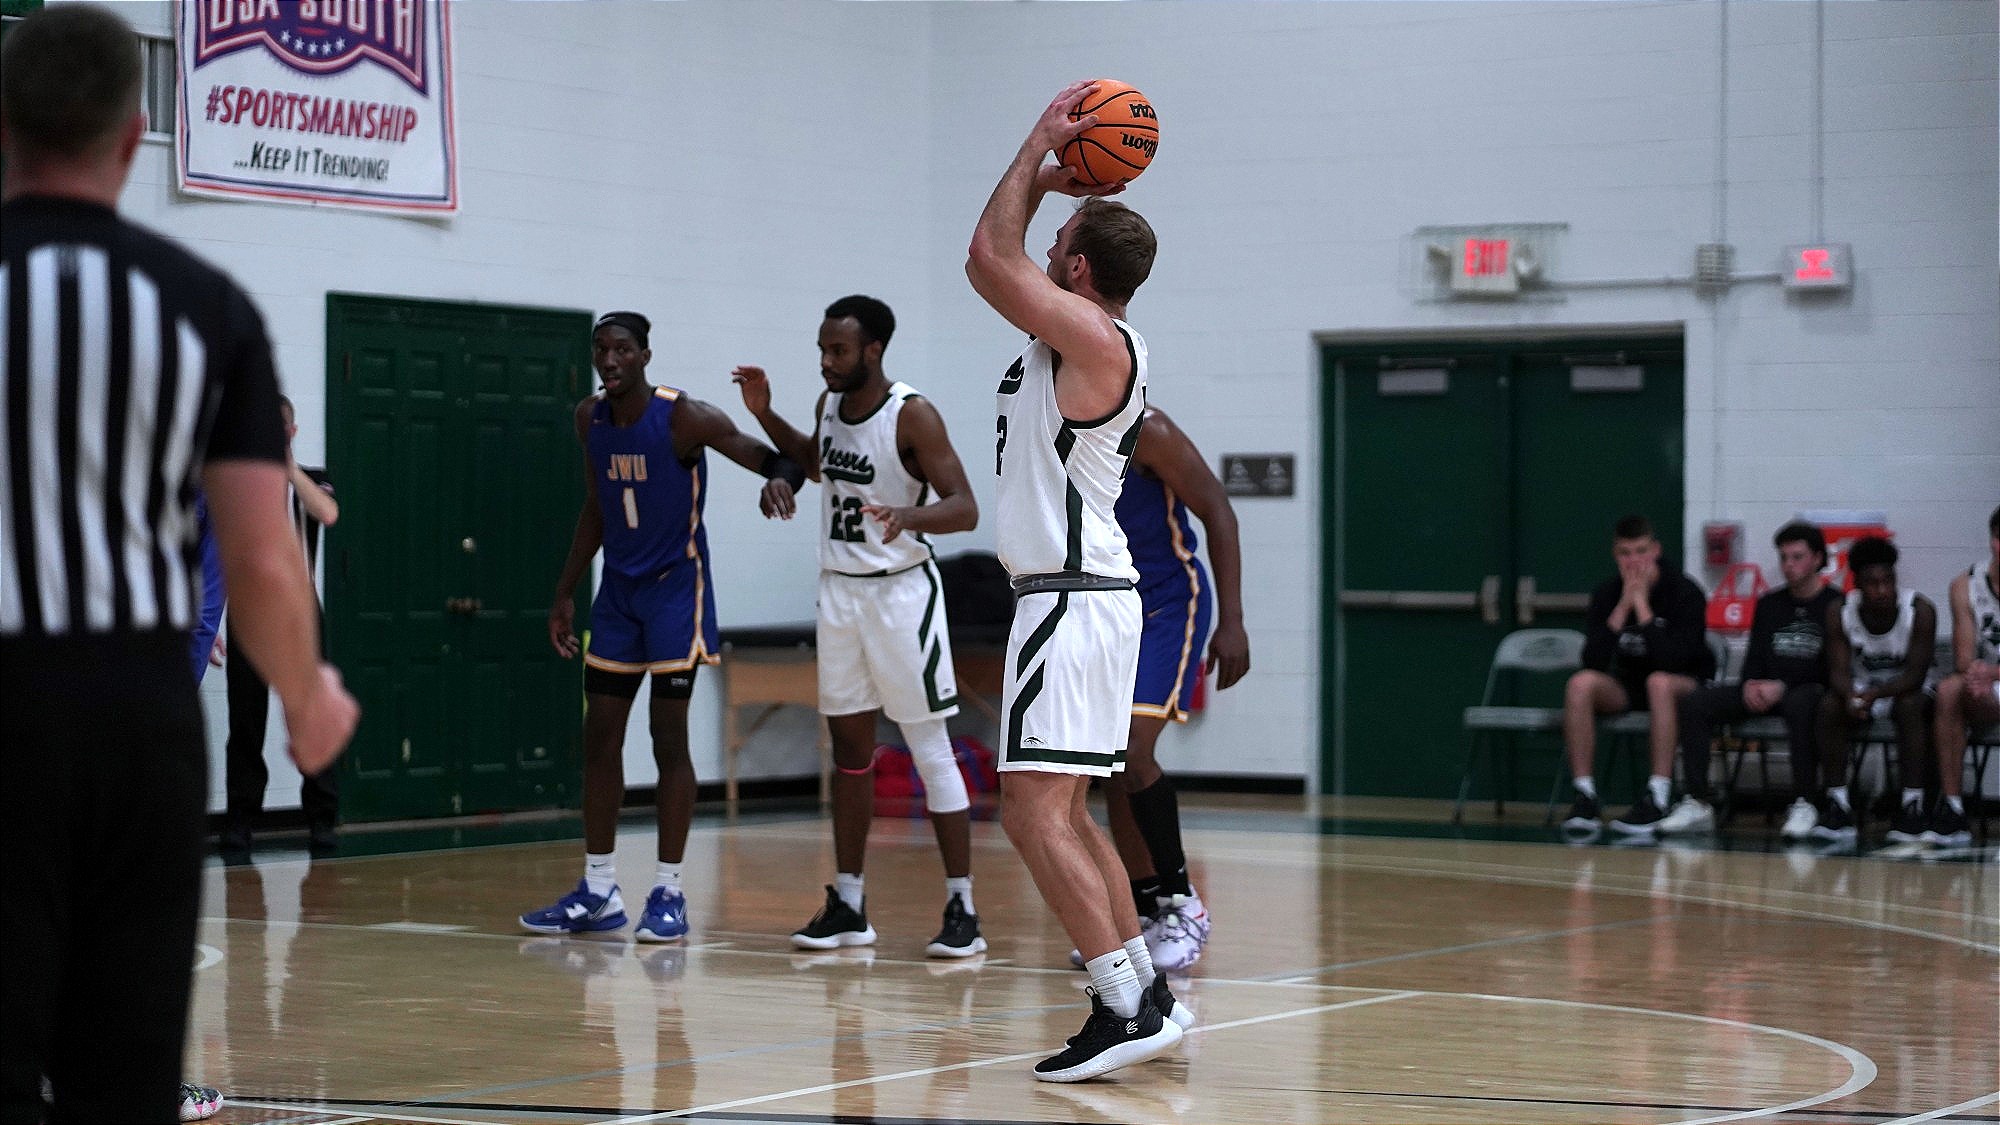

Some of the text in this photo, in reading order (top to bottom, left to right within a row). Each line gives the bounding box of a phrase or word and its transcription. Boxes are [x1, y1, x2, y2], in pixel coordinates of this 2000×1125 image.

[206, 85, 419, 143] #SPORTSMANSHIP
[1129, 103, 1158, 120] CAA
[1121, 132, 1159, 159] lson
[1464, 239, 1508, 276] EXIT
[607, 453, 648, 481] JWU
[622, 487, 639, 529] 1
[830, 494, 866, 542] 22
